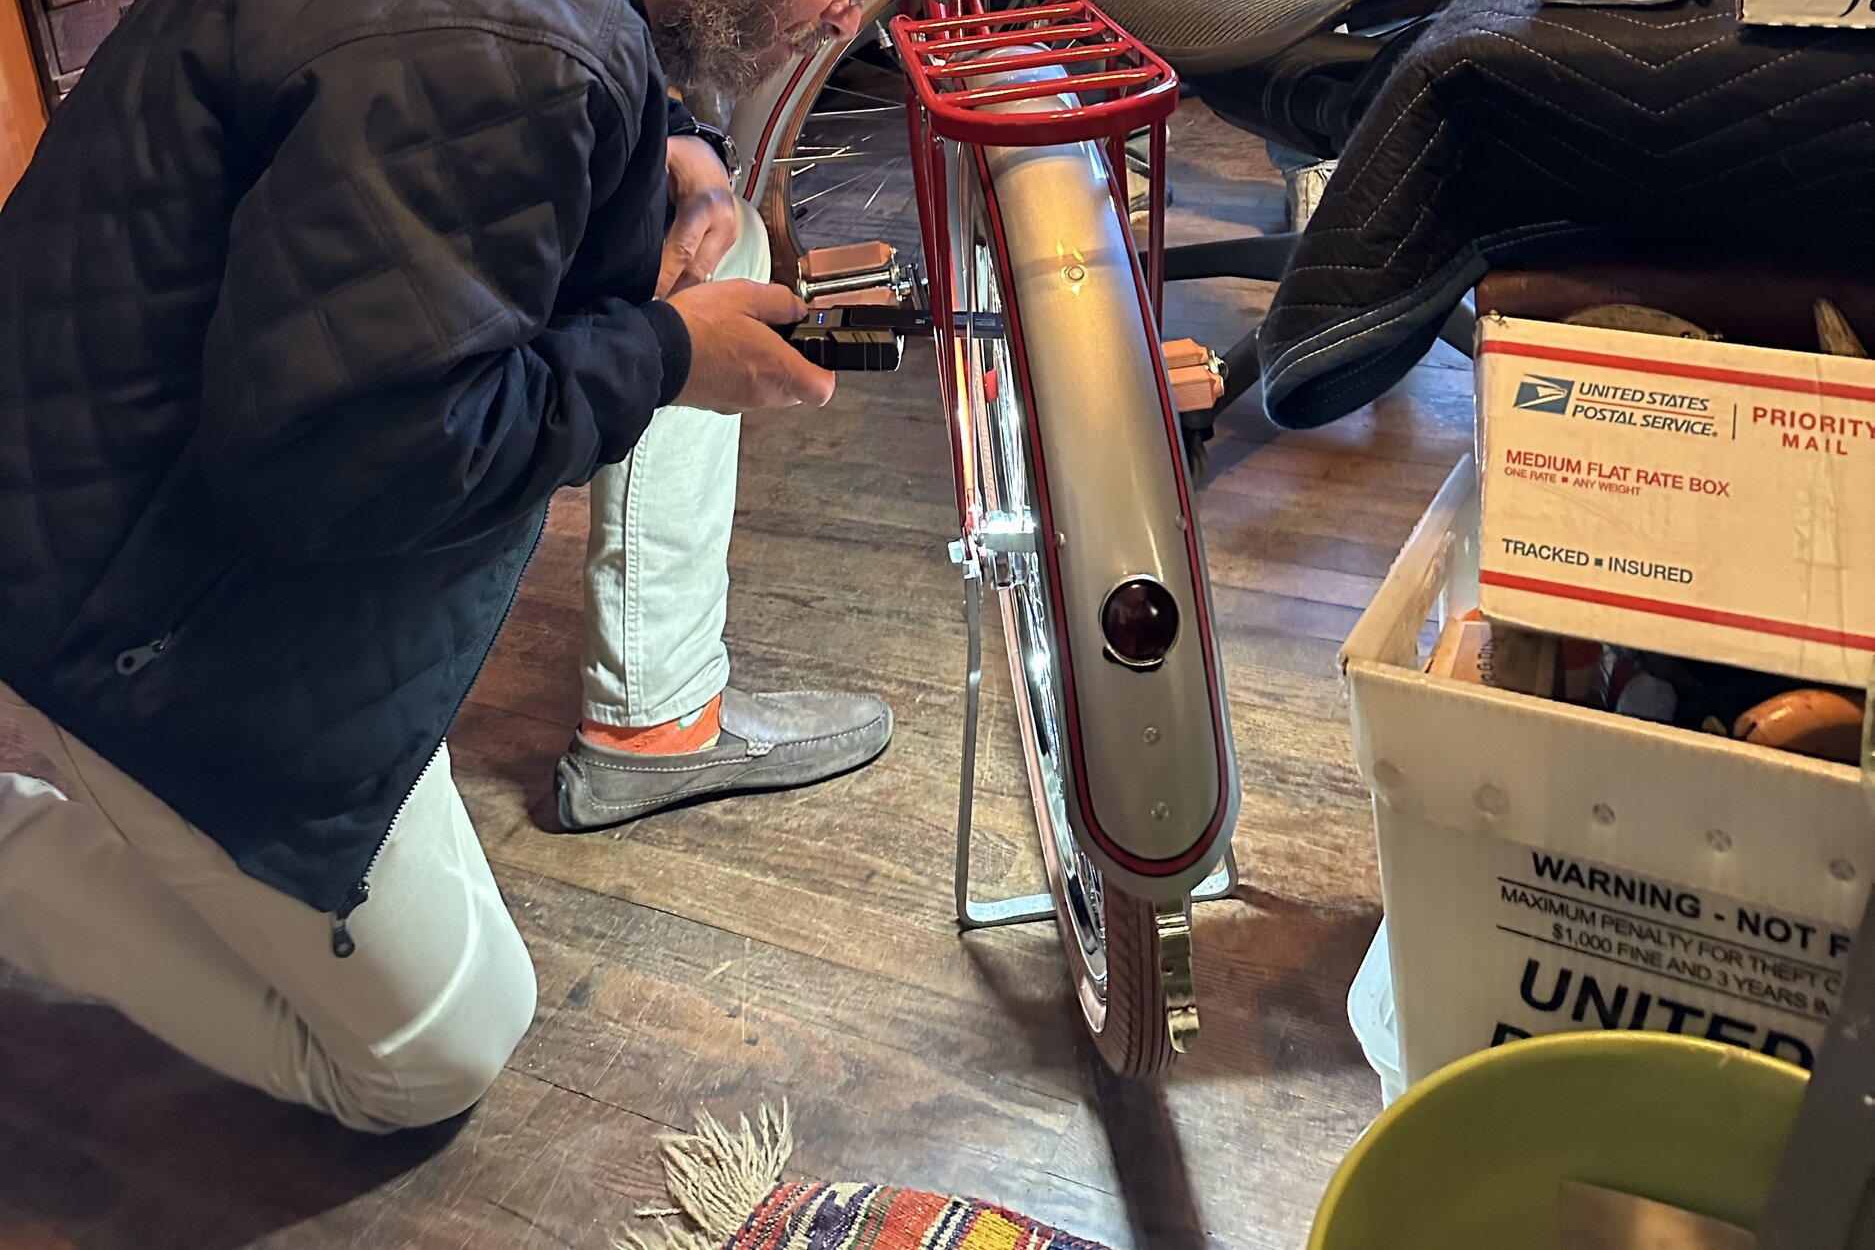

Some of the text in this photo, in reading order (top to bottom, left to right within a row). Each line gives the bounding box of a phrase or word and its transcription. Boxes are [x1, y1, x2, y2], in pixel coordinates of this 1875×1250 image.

[1572, 404, 1638, 426] POSTAL
[1579, 381, 1710, 412] UNITED STATES
[1752, 406, 1875, 440] PRIORITY
[1782, 432, 1848, 456] MAIL
[1504, 466, 1642, 497] ONE RATE ANY WEIGHT
[1505, 449, 1731, 497] MEDIUM FLAT RATE BOX
[1501, 537, 1693, 584] TRACKED INSURED
[1531, 851, 1701, 919] WARNING
[1737, 907, 1817, 949] NOT
[1501, 885, 1596, 927] MAXIMUM
[1601, 913, 1694, 949] PENALTY
[1697, 940, 1744, 969] FOR
[1747, 954, 1820, 988] THEFT
[1552, 922, 1613, 953] $1,000
[1617, 941, 1663, 969] FINE
[1666, 956, 1713, 982] AND
[1716, 969, 1730, 987] 3
[1732, 974, 1809, 1010] YEARS
